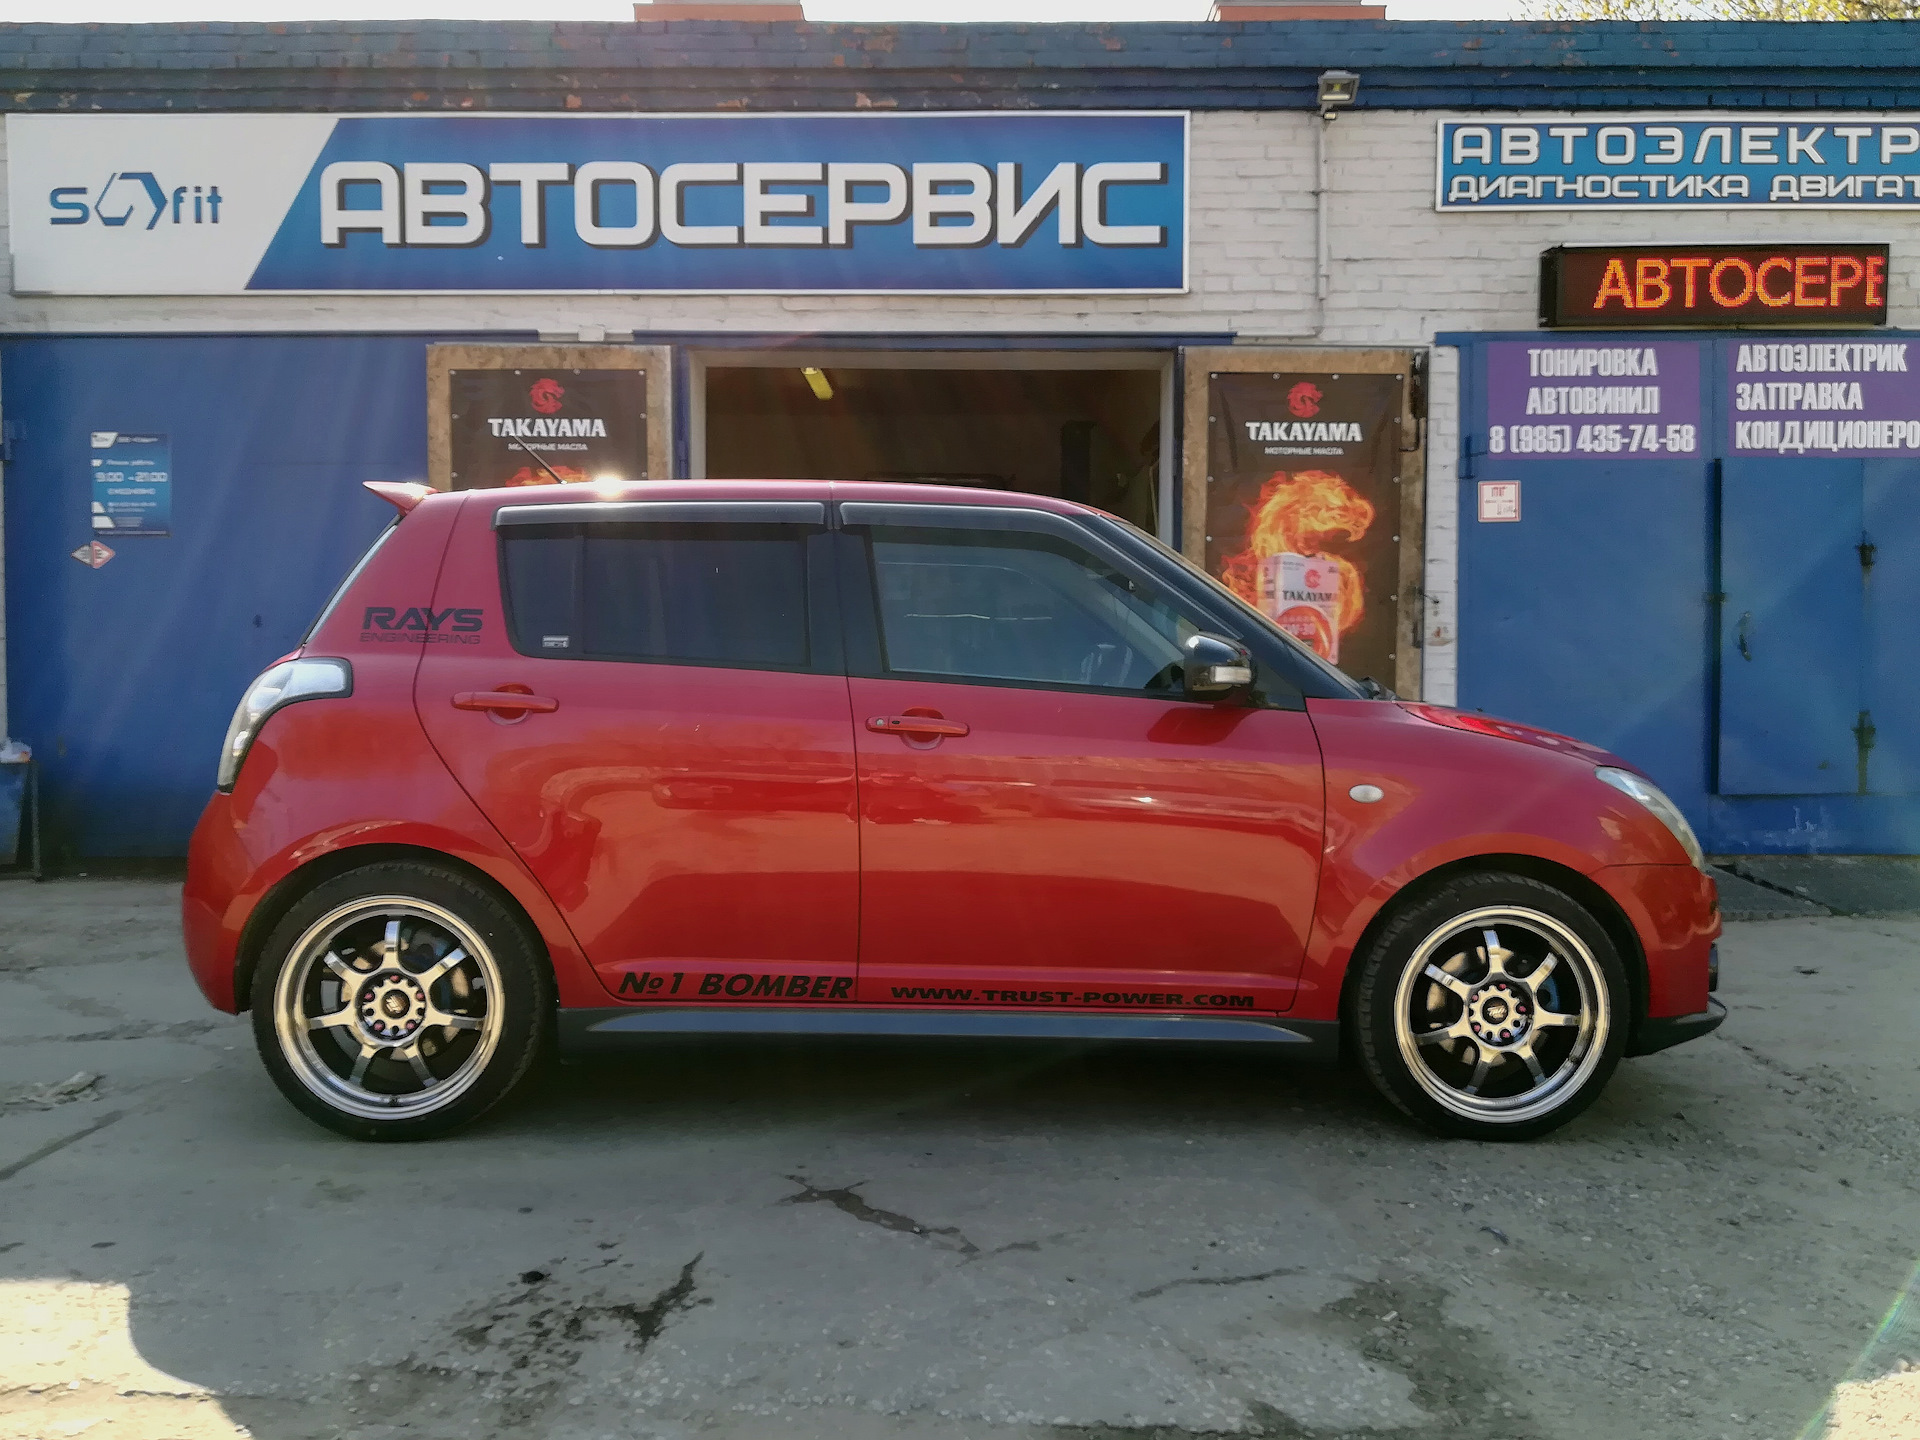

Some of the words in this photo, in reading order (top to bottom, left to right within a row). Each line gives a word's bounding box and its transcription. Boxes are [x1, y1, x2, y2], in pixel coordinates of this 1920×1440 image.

[1453, 126, 1919, 165] АВТОЭЛЕКТР
[1449, 175, 1750, 202] ДИАГНОСТИКА
[319, 161, 1167, 249] АВТОСЕРВИС
[1527, 348, 1659, 377] ТОНИРОВКА
[1735, 344, 1908, 373] АВТОЭЛЕКТРИК
[1525, 386, 1661, 415] АВТОВИНИЛ
[1735, 382, 1863, 411] ЗАПРАВКА
[487, 418, 607, 438] TAKAYAMA
[1245, 421, 1364, 442] TAKAYAMA
[1489, 425, 1506, 453] 8
[1575, 424, 1696, 453] 435-74-58
[1735, 420, 1920, 455] КОНДИЦИОНЕРО
[362, 606, 484, 632] RAYS
[359, 631, 481, 645] ENGINEERING
[698, 972, 853, 999] BOMBER
